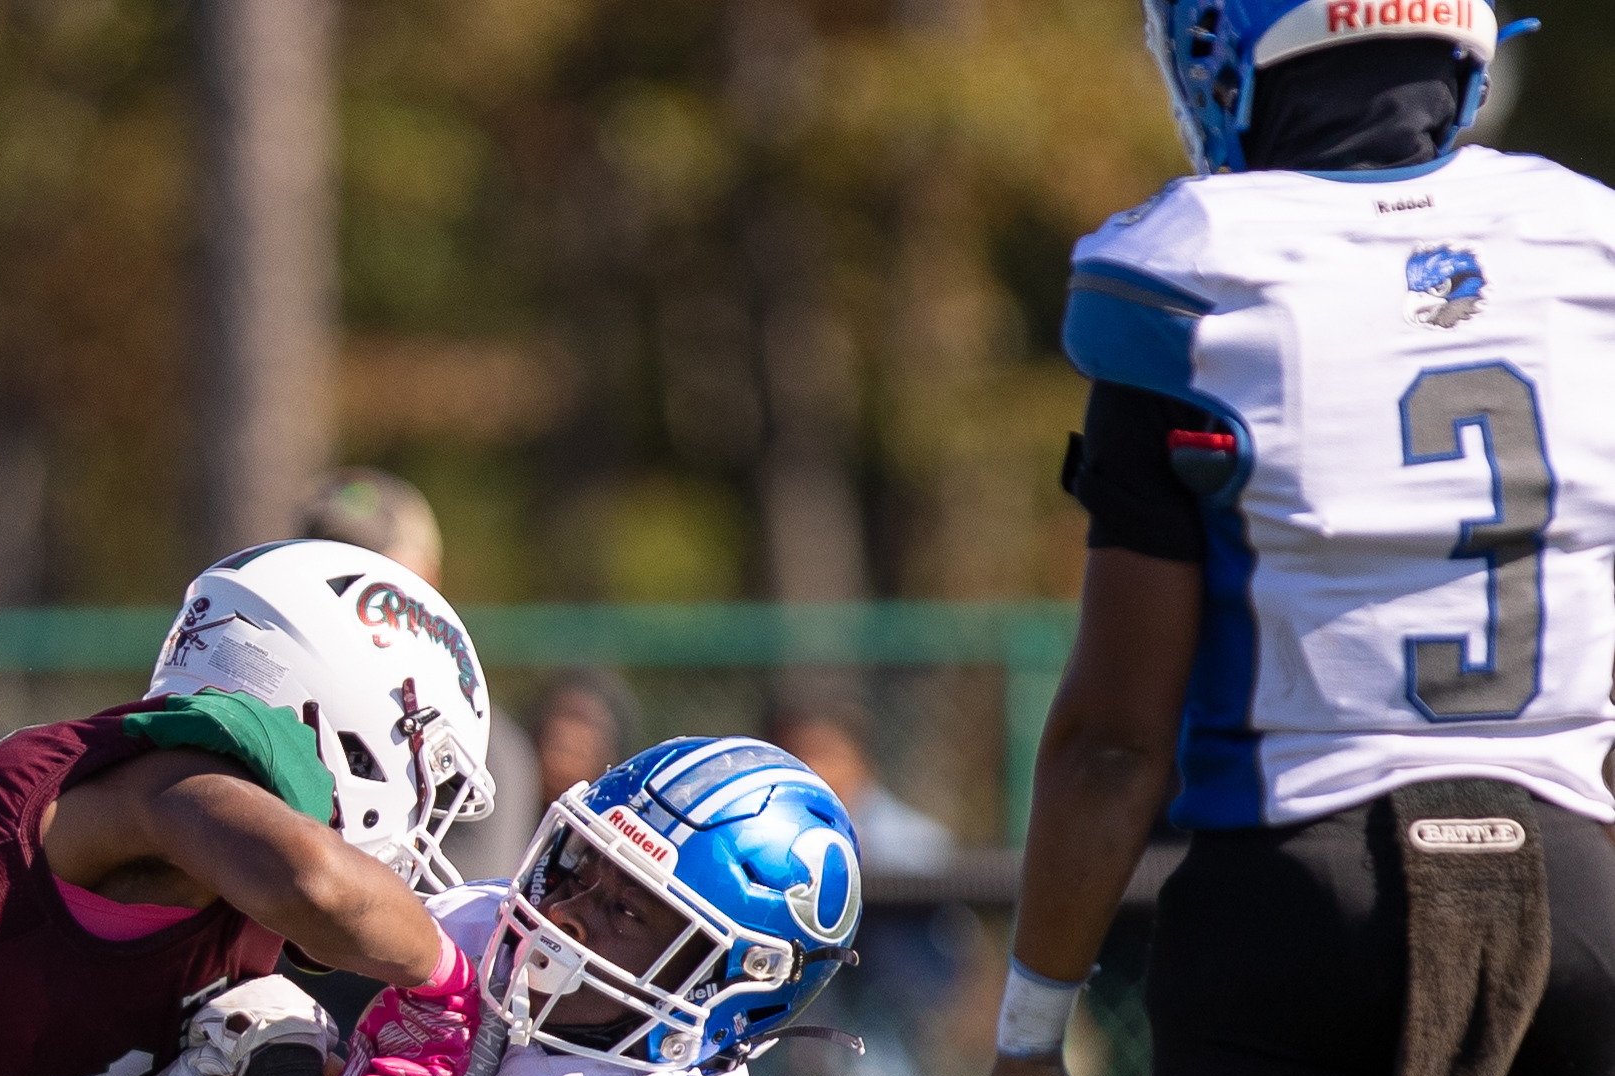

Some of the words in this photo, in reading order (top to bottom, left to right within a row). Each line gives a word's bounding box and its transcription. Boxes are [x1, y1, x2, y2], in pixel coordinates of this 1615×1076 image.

[1398, 358, 1558, 724] 3
[608, 808, 670, 863] Riddell
[1419, 823, 1518, 843] BATTLE
